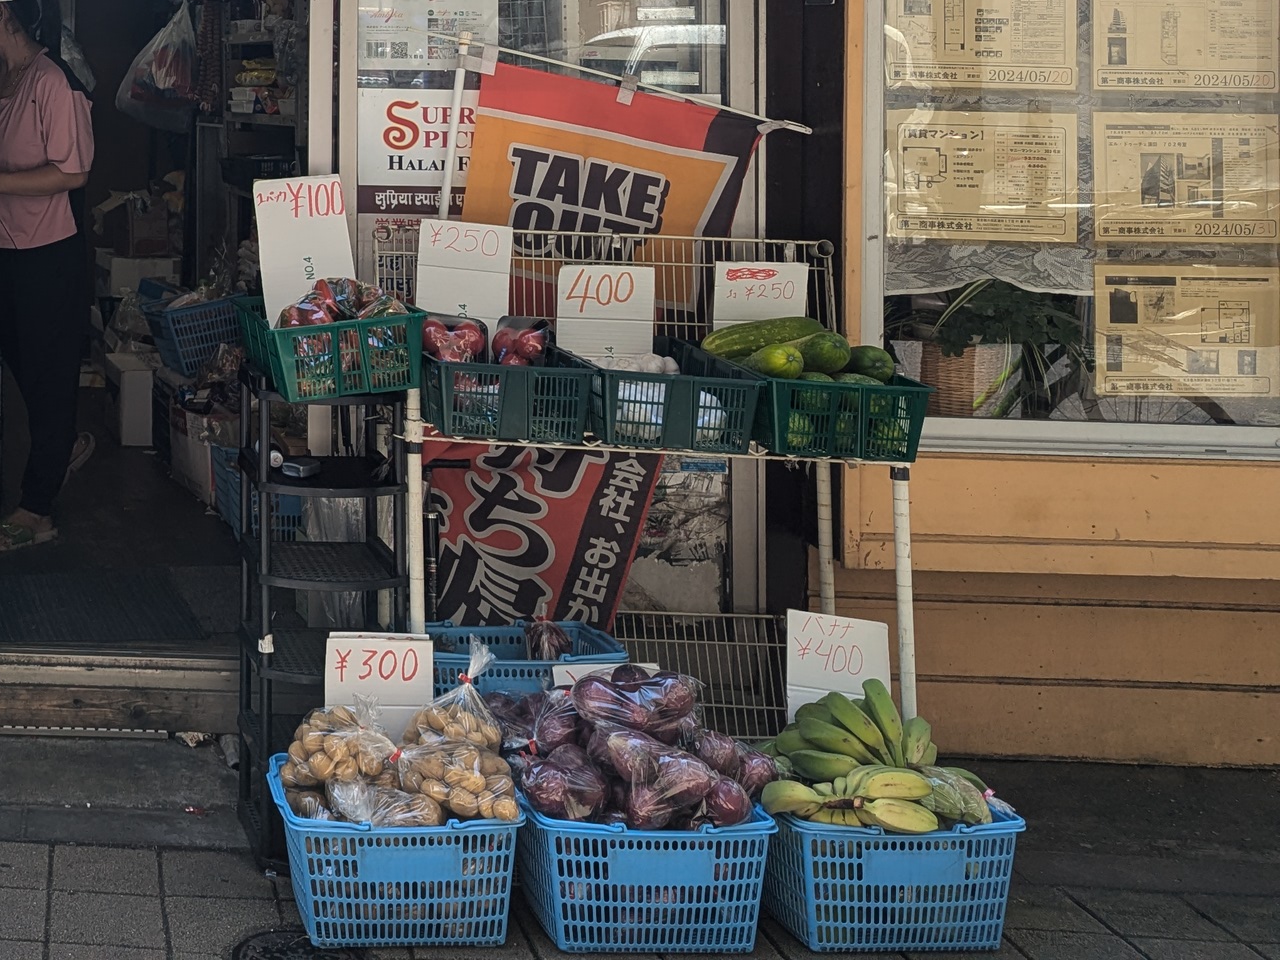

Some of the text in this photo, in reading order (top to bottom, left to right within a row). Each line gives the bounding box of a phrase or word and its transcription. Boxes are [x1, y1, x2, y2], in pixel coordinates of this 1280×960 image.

[893, 68, 1068, 84] 第一商事株式会社 2024/05/20
[1101, 73, 1270, 87] 第一商事株式会社 2024/05/20
[286, 181, 345, 217] ¥100
[509, 144, 668, 225] TAKE
[431, 223, 500, 257] ¥250
[511, 200, 645, 263] OUT
[900, 220, 973, 231] 第一商事株式会社
[1102, 226, 1165, 235] 第一商事株式会社
[303, 256, 315, 280] NO.4
[566, 268, 634, 313] 400
[745, 280, 795, 301] ¥250
[802, 616, 854, 639] バナナ
[335, 648, 418, 682] ¥300
[794, 637, 863, 676] ¥400
